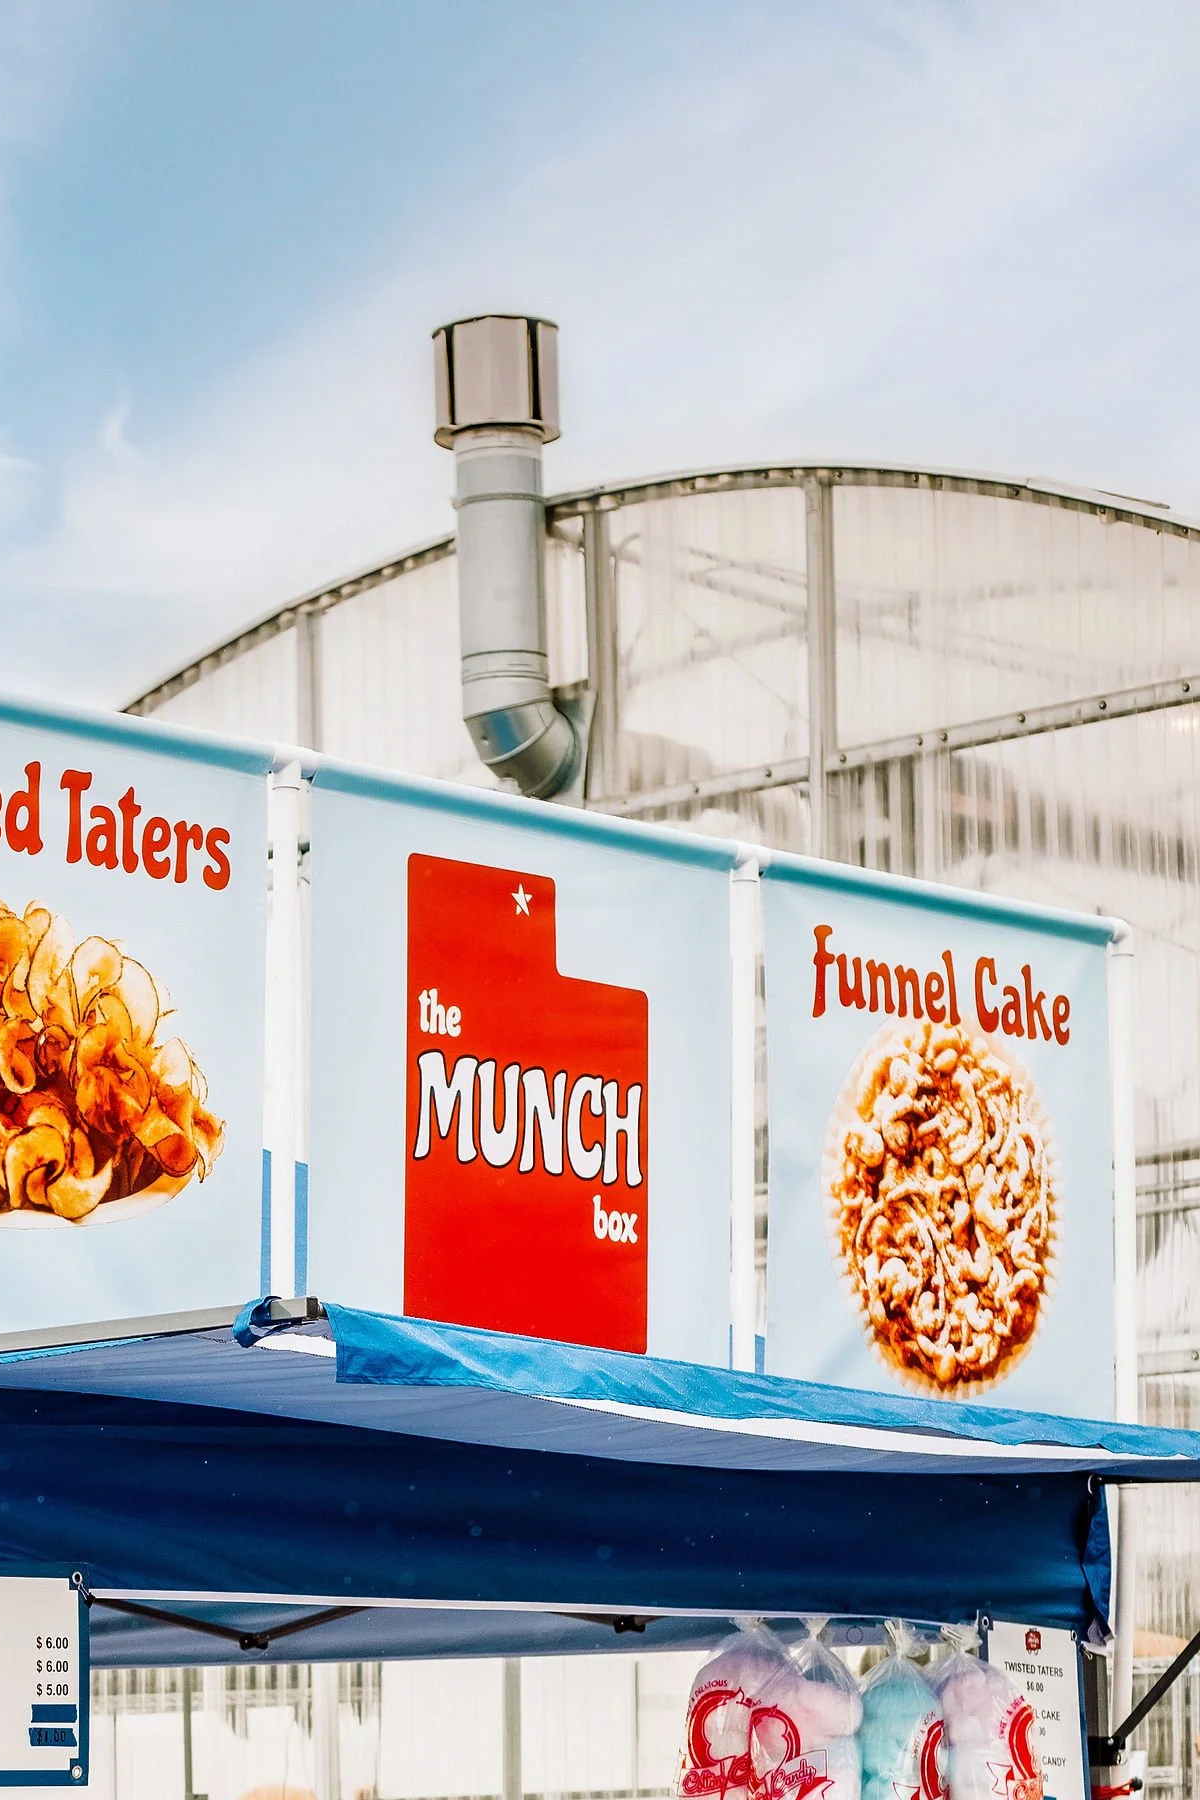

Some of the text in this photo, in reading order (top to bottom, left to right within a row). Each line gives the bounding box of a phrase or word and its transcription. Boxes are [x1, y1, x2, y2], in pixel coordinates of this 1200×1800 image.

[59, 768, 231, 890] Taters
[974, 955, 1072, 1046] Cake
[417, 986, 462, 1037] the
[413, 1050, 645, 1188] MUNCH
[593, 1194, 638, 1244] box
[36, 1636, 43, 1650] $
[46, 1636, 69, 1650] 6.00
[36, 1660, 43, 1674] $
[46, 1660, 69, 1673] 6.00
[1004, 1660, 1064, 1678] TWISTED TATERS
[36, 1684, 43, 1697] $
[46, 1684, 69, 1696] 5.00
[1026, 1681, 1044, 1693] $6.00
[1041, 1711, 1061, 1722] CAKE
[1042, 1756, 1066, 1767] CANDY
[771, 1758, 817, 1798] Candy
